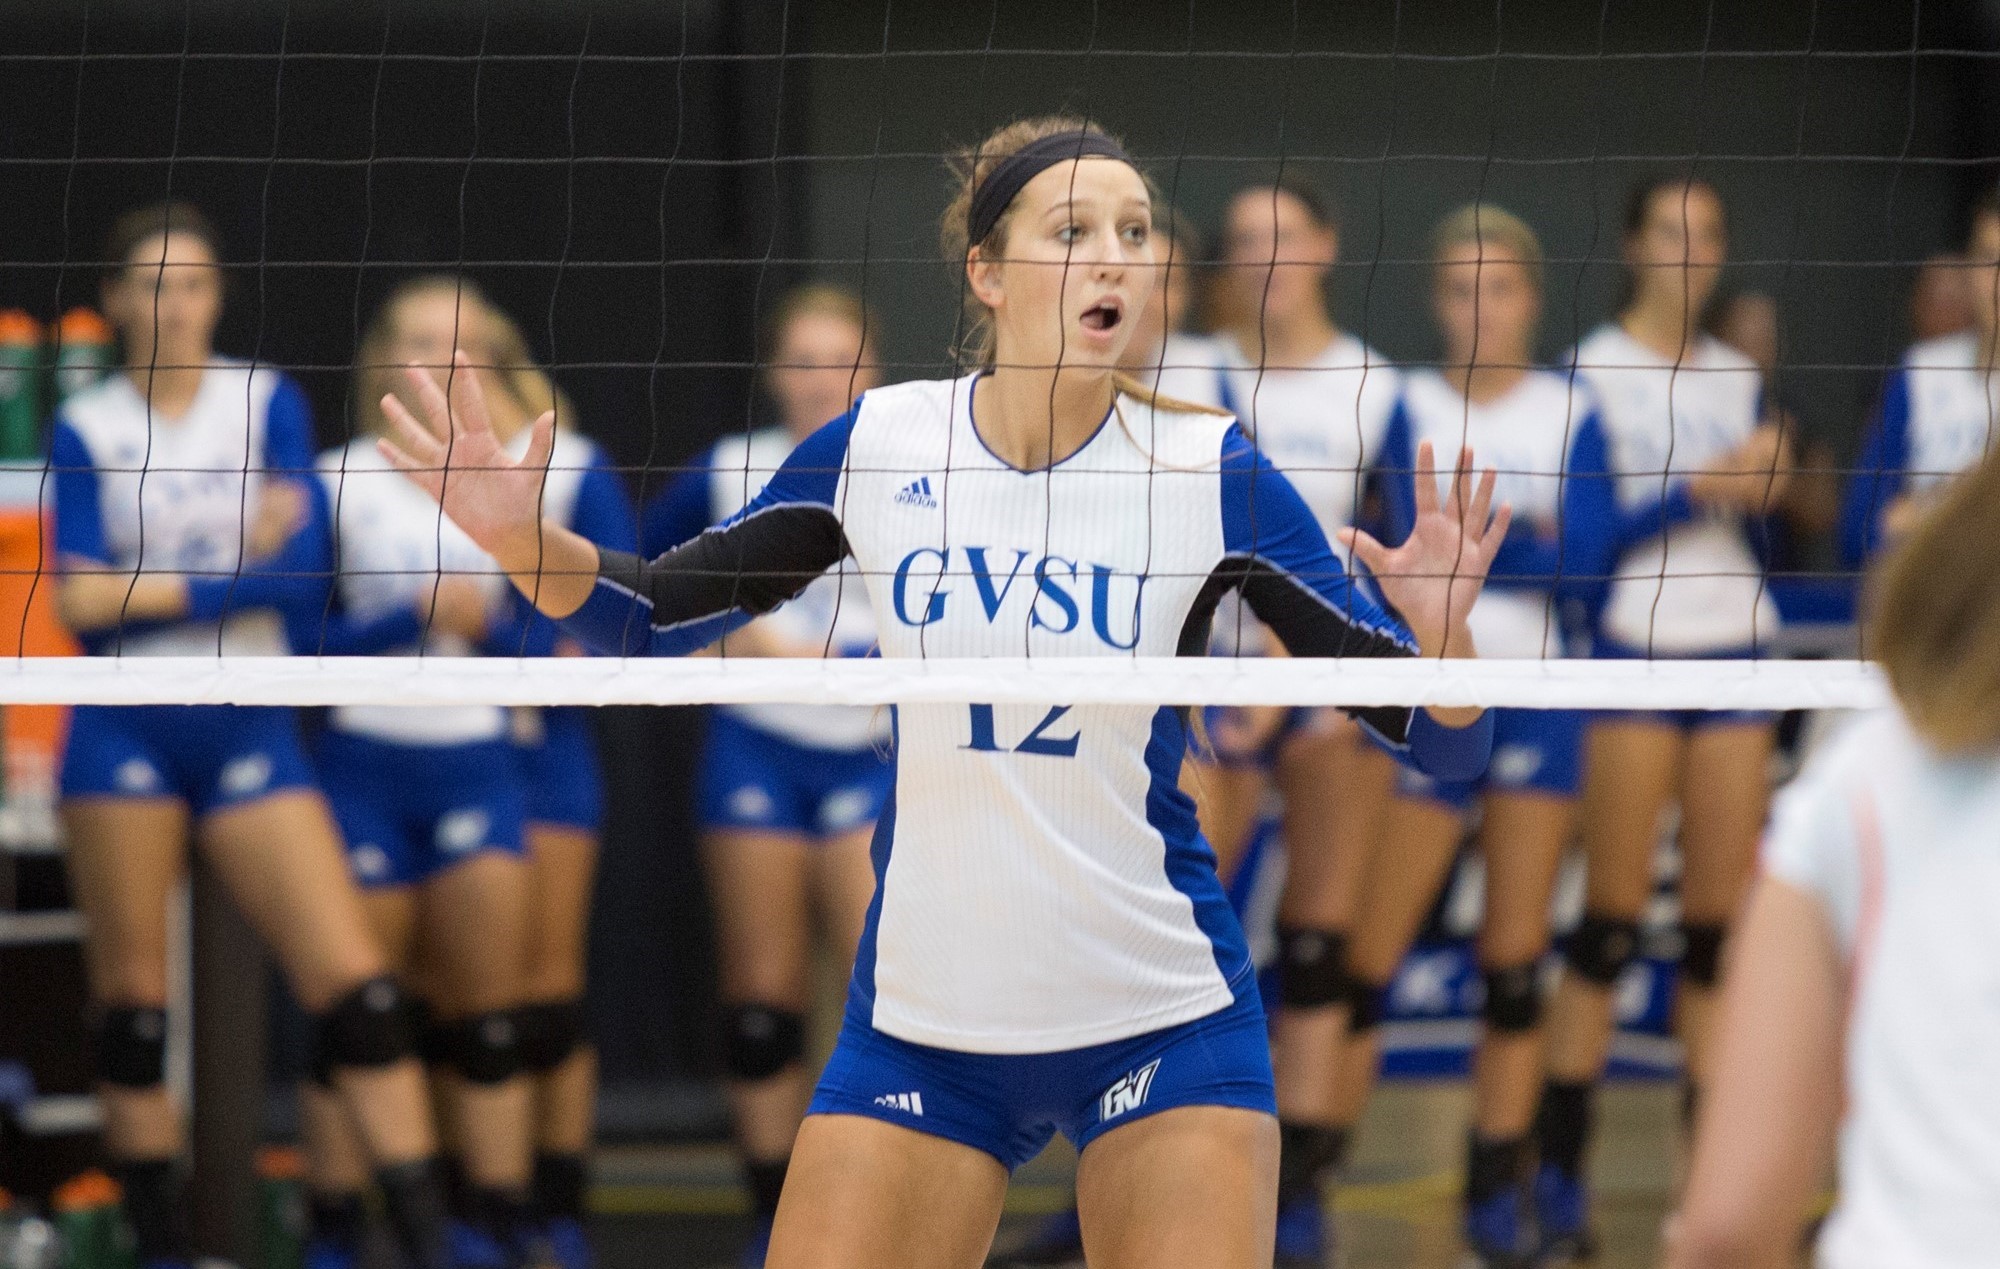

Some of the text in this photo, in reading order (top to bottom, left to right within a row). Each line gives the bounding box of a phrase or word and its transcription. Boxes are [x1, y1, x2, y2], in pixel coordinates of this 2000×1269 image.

[894, 492, 938, 509] adidas
[893, 546, 1151, 651] GVSU
[957, 703, 1082, 758] 12
